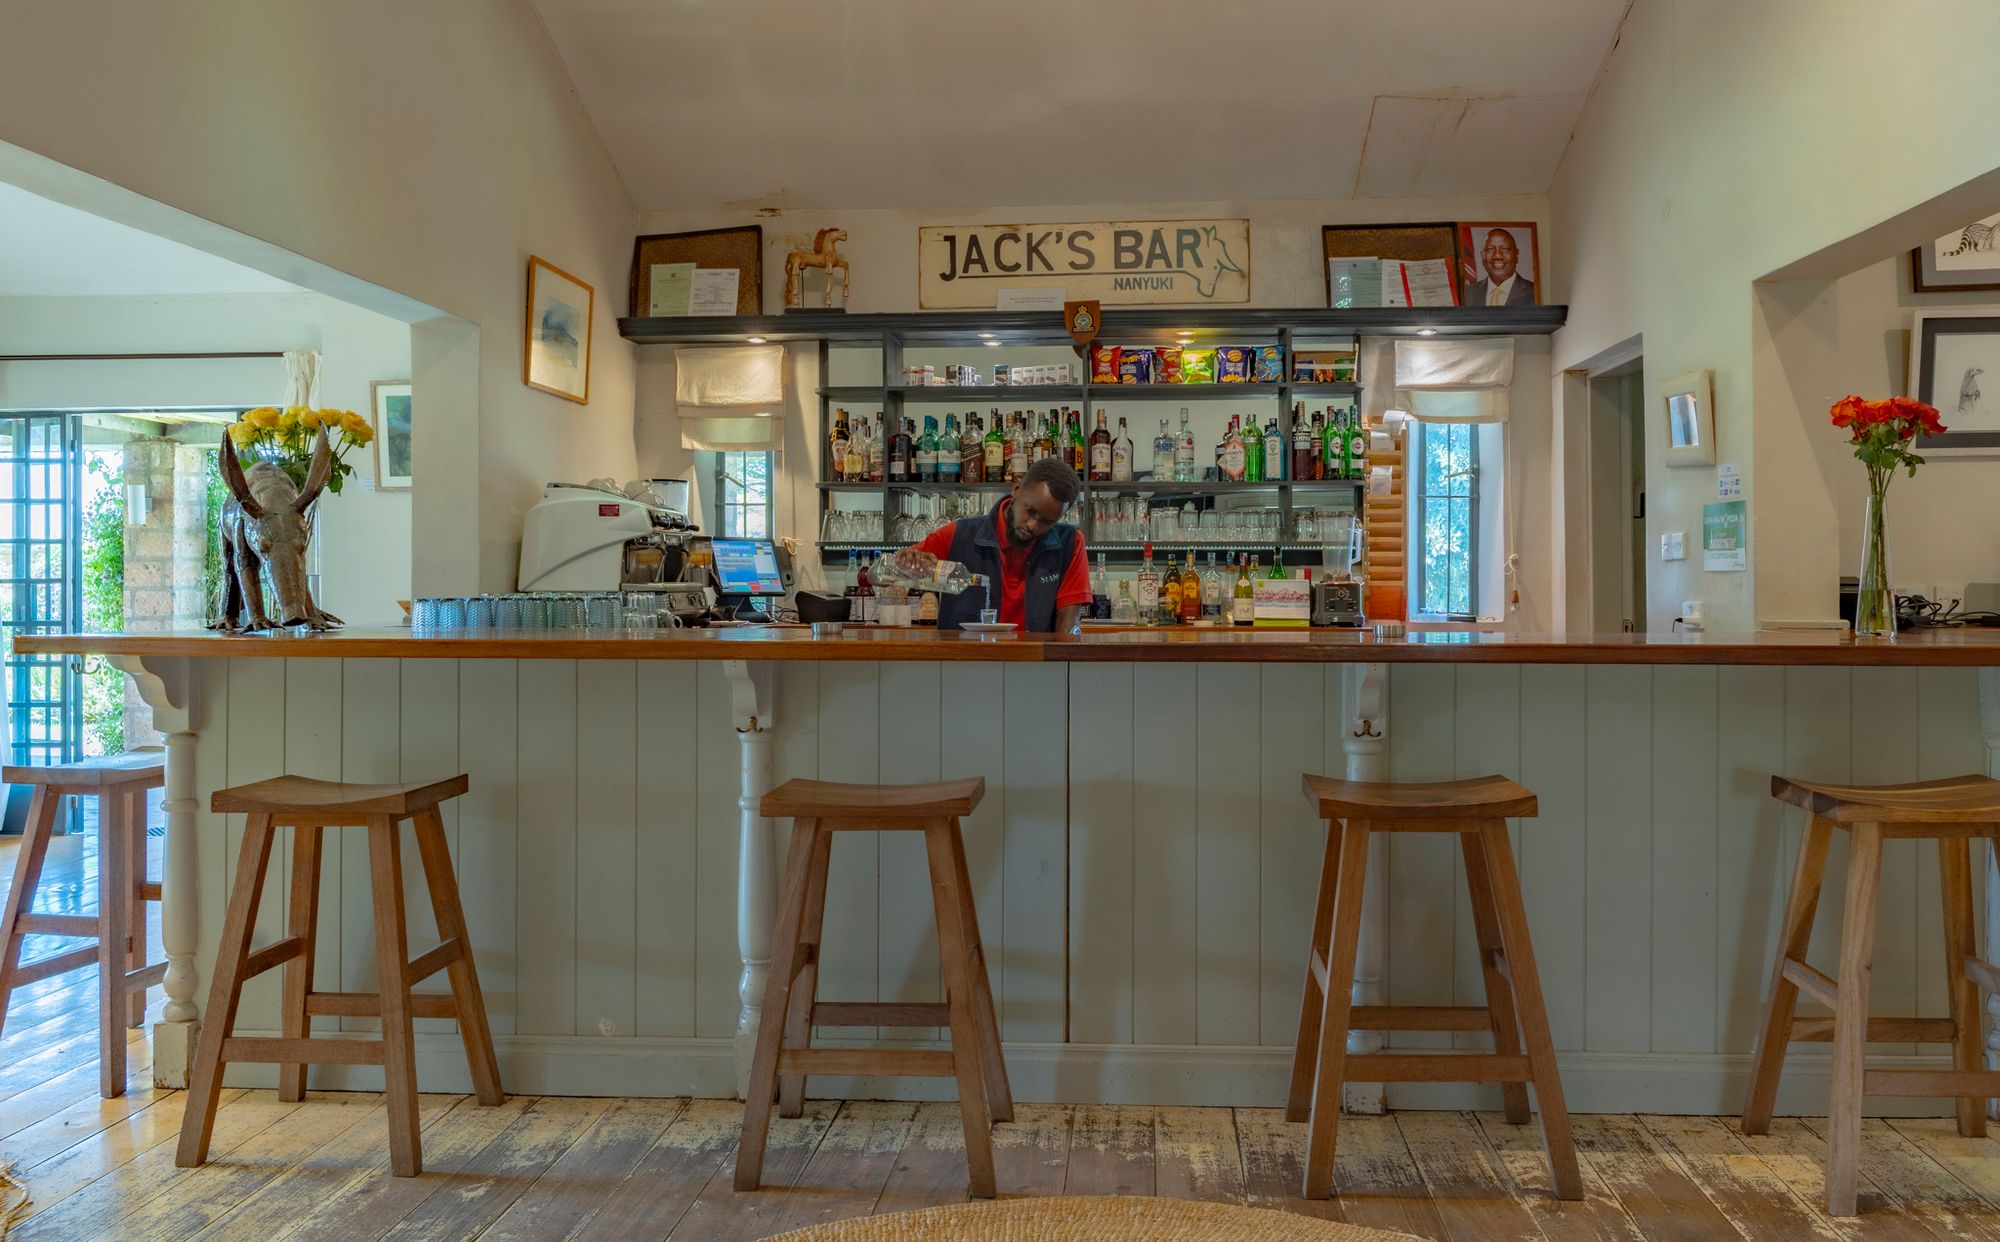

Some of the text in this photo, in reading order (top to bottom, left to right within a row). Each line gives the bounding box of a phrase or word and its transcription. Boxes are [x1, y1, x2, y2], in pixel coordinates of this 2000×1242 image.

[939, 228, 1204, 282] JACK'S BAR
[1114, 276, 1173, 291] NANYUKI
